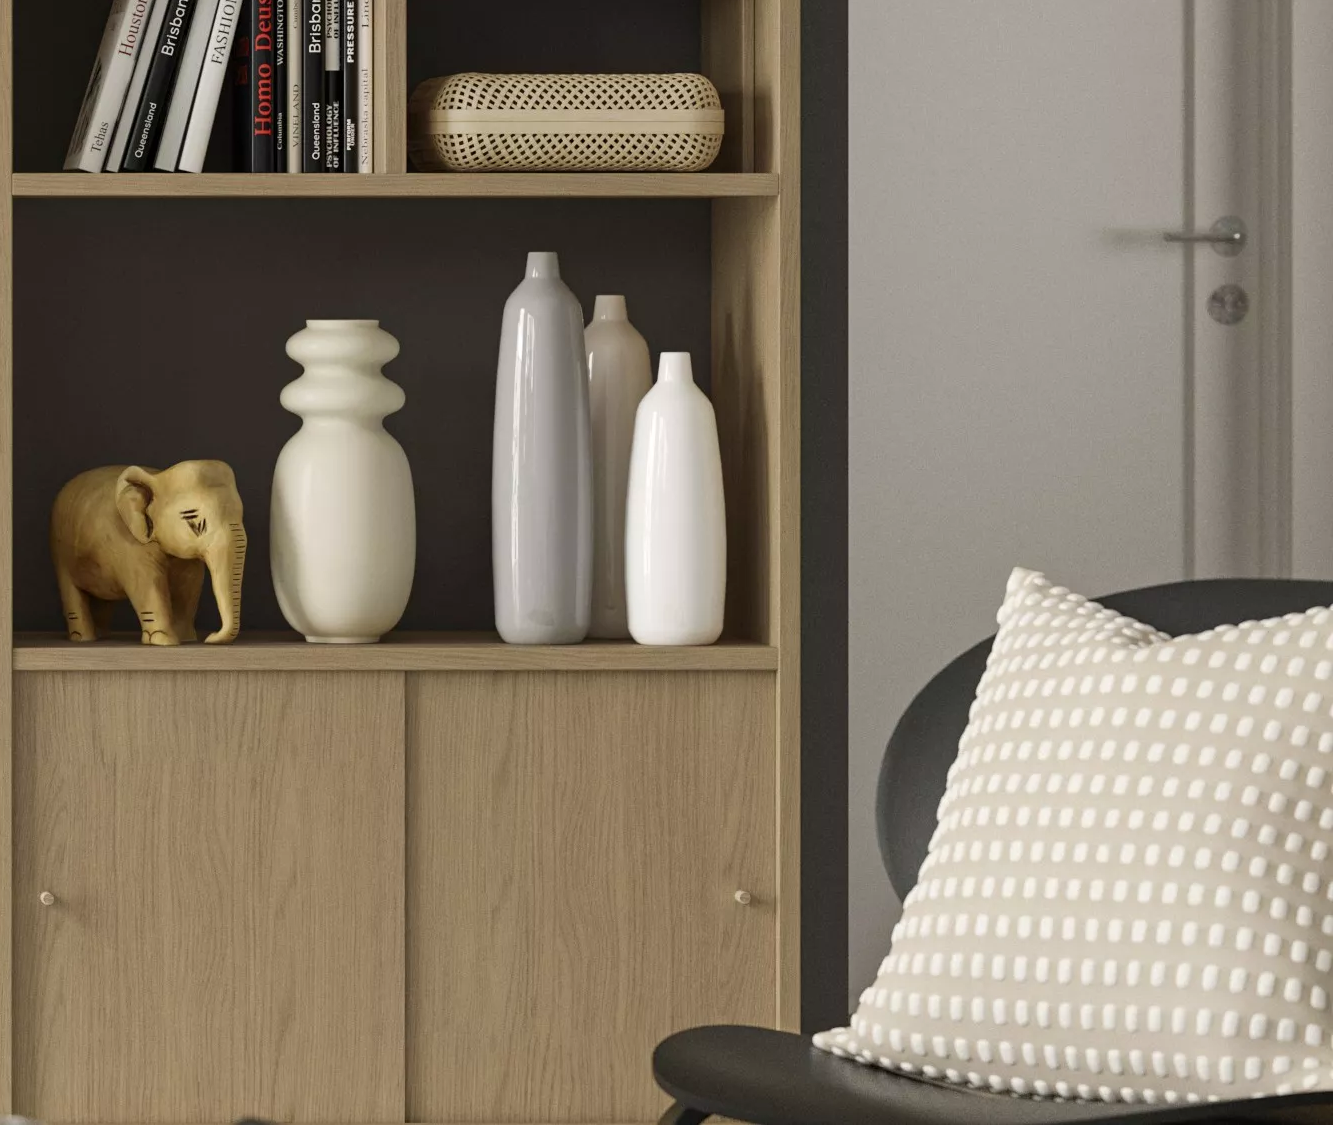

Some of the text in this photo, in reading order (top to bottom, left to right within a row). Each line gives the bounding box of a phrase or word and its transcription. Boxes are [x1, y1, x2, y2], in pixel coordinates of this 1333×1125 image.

[333, 27, 340, 39] OF
[346, 0, 355, 64] PRESSURE
[254, 63, 272, 137] Homo
[292, 83, 300, 148] VINELAND
[361, 68, 370, 108] capital
[90, 121, 109, 154] Tehas
[134, 102, 157, 159] Queensland
[276, 112, 284, 151] Columbia
[311, 102, 321, 161] Queensland
[326, 104, 334, 168] PSYCHOLOGY
[361, 109, 370, 165] Nebraska
[333, 156, 340, 169] OF
